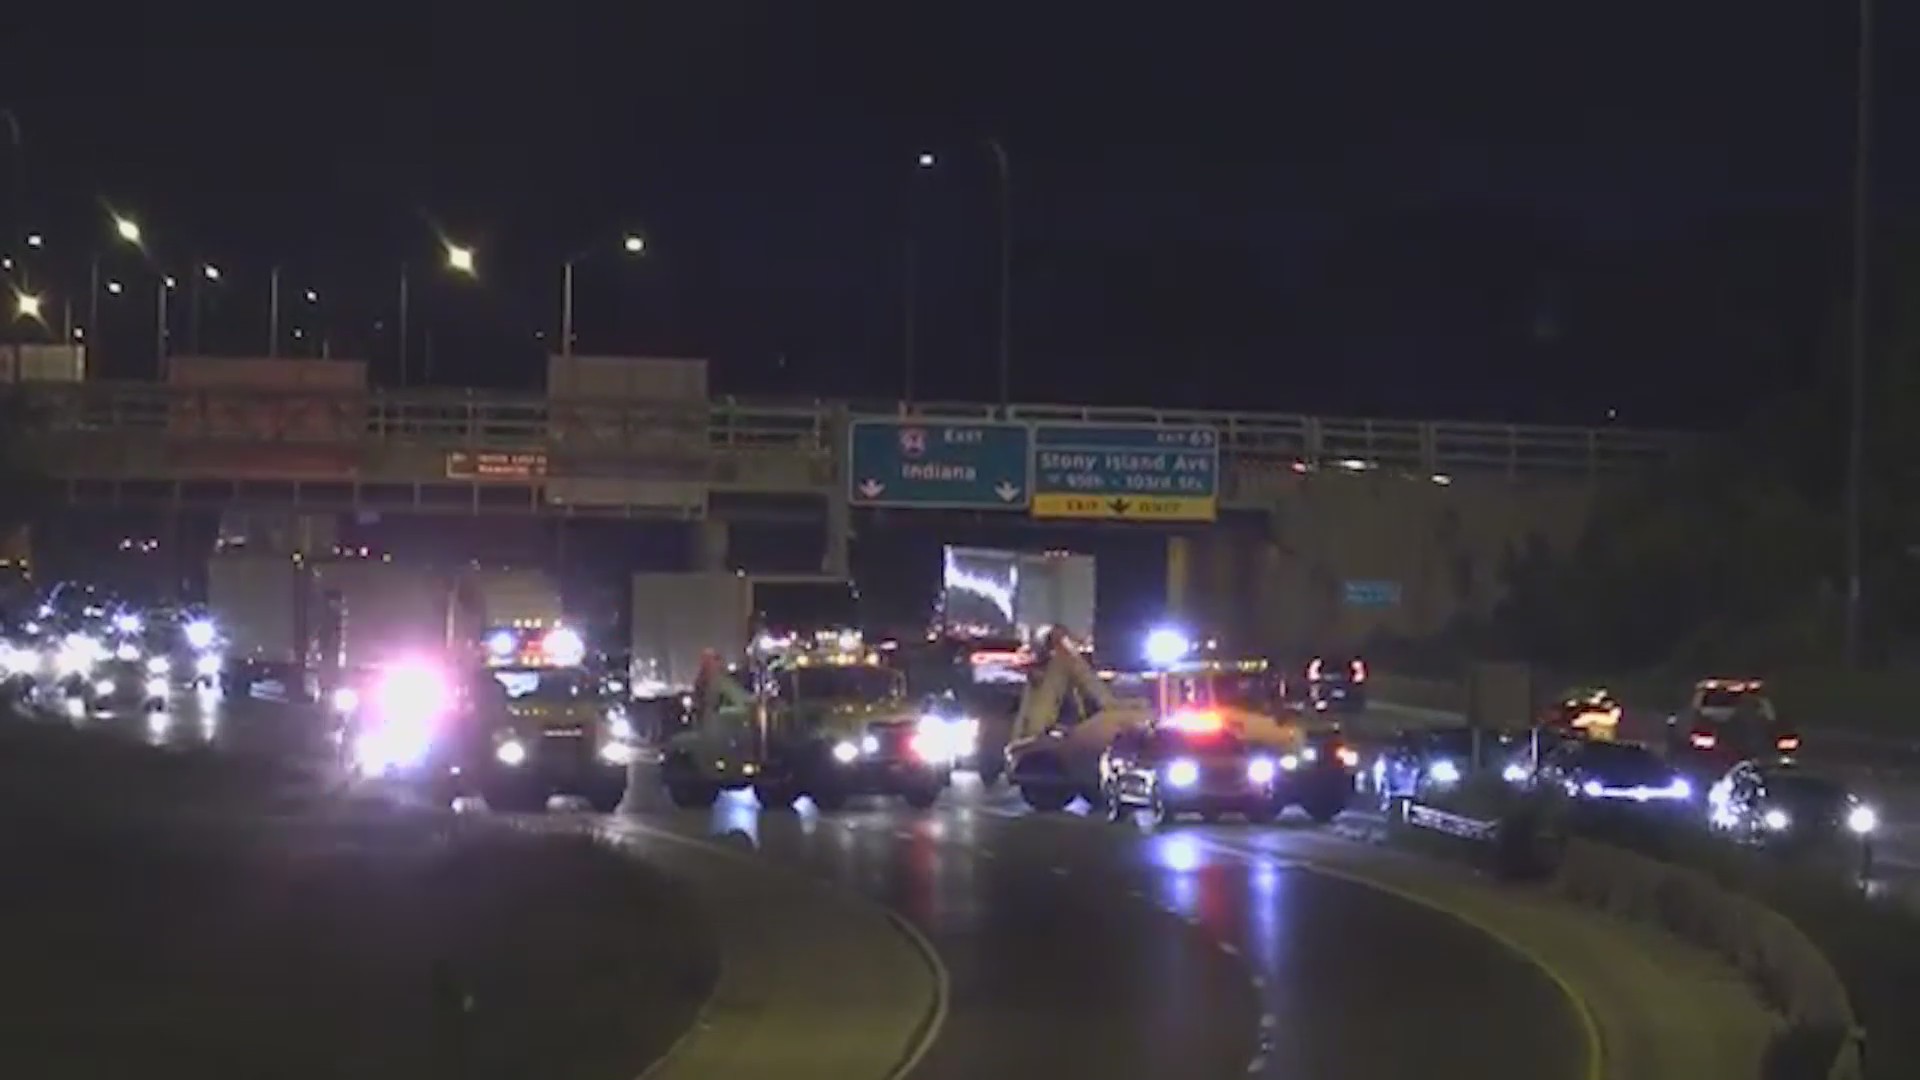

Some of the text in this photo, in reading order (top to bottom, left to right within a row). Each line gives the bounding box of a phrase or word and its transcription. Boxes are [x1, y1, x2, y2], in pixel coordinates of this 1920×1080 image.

[1041, 453, 1208, 471] Stony Island Ave
[902, 462, 976, 481] Indiana
